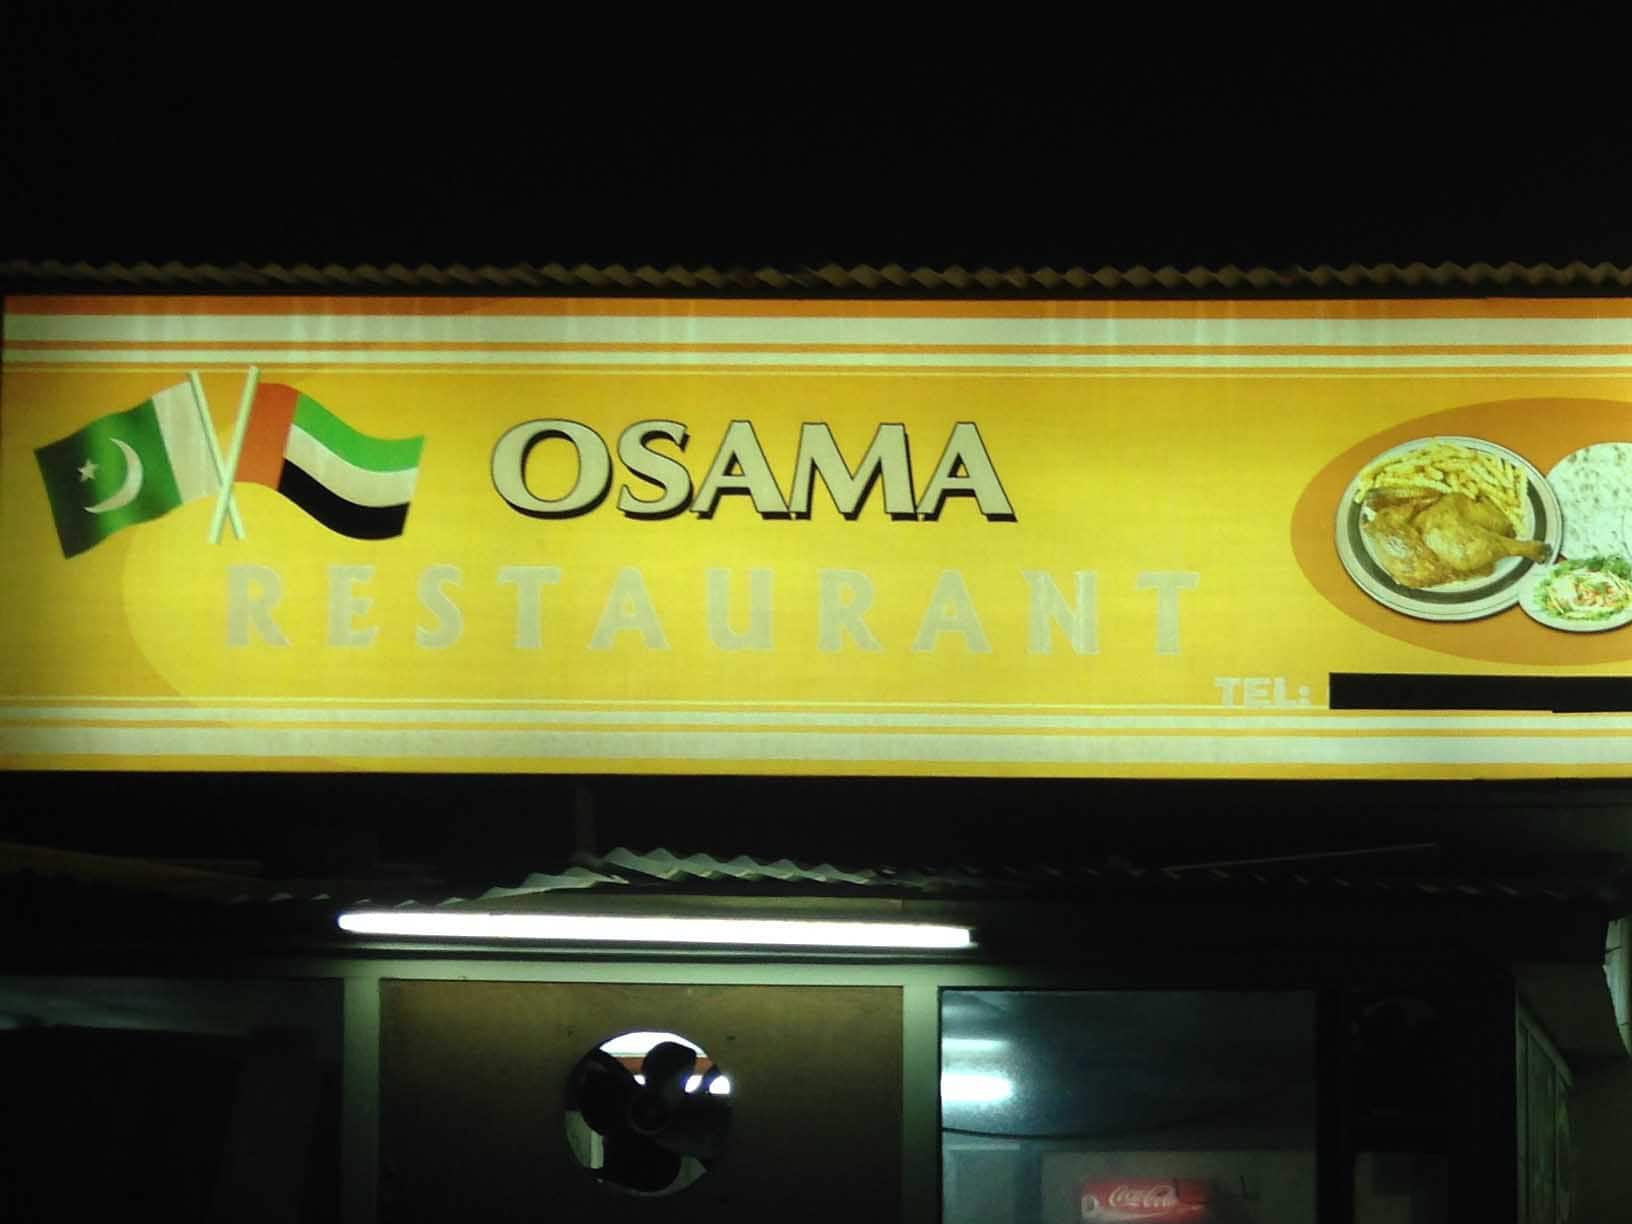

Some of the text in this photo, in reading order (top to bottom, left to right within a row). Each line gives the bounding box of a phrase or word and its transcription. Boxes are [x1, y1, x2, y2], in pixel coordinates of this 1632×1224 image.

[490, 417, 1017, 522] OSAMA
[224, 563, 1202, 658] RESTAURANT
[1214, 675, 1313, 710] TEL:
